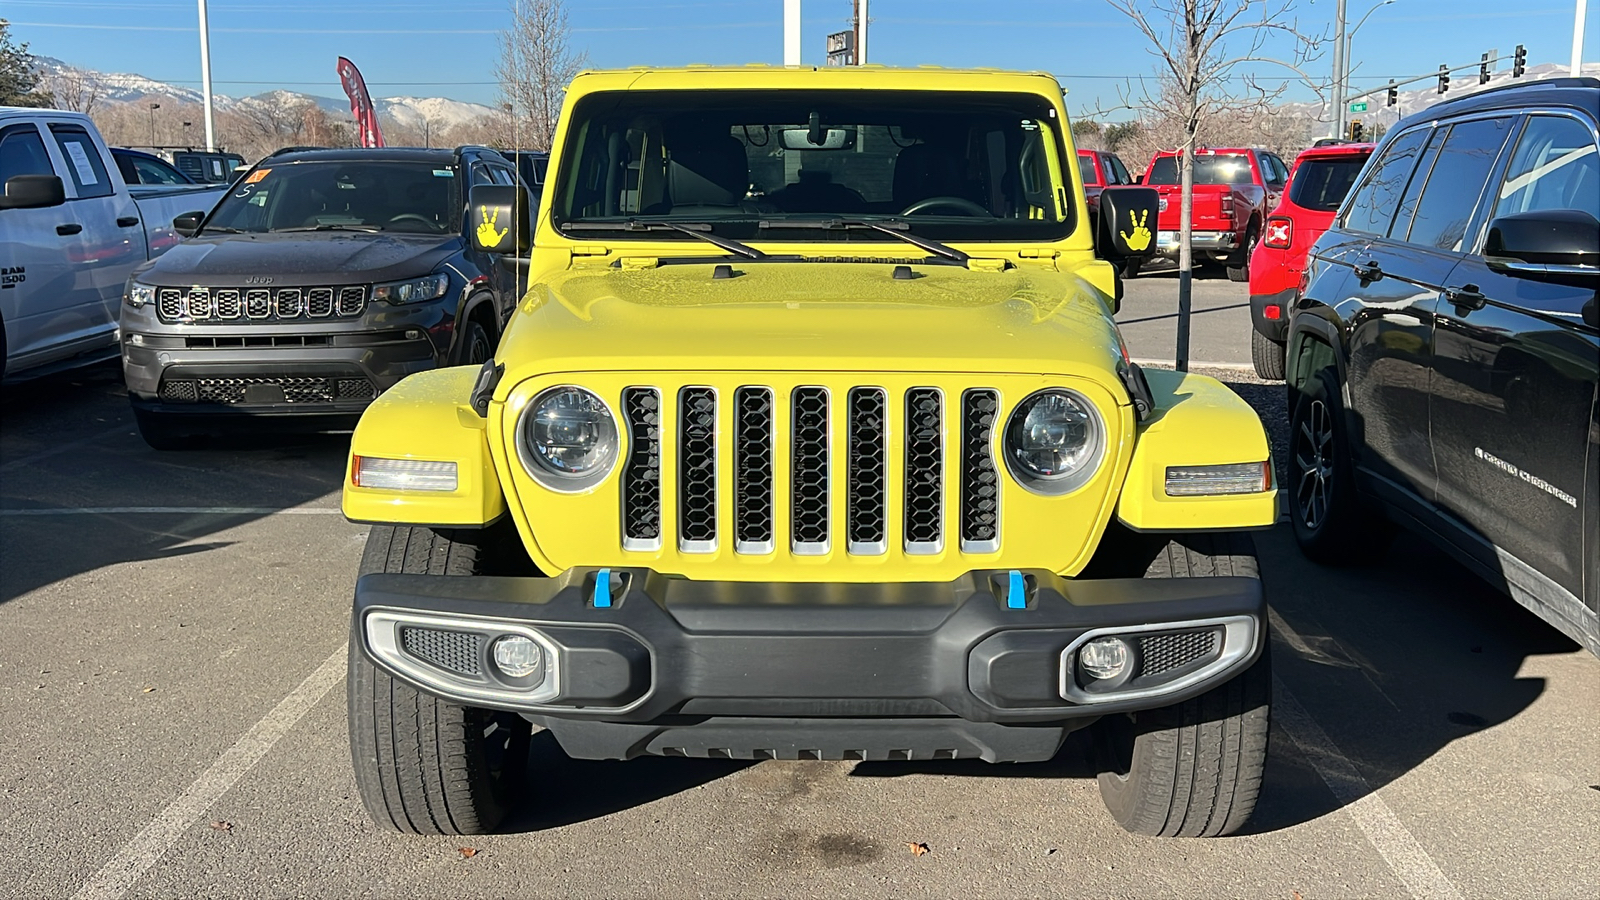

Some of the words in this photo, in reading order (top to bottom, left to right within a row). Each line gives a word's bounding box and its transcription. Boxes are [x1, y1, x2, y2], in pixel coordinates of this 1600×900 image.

[1, 266, 25, 275] RAM
[2, 274, 26, 284] 1500
[246, 275, 274, 285] Jeep
